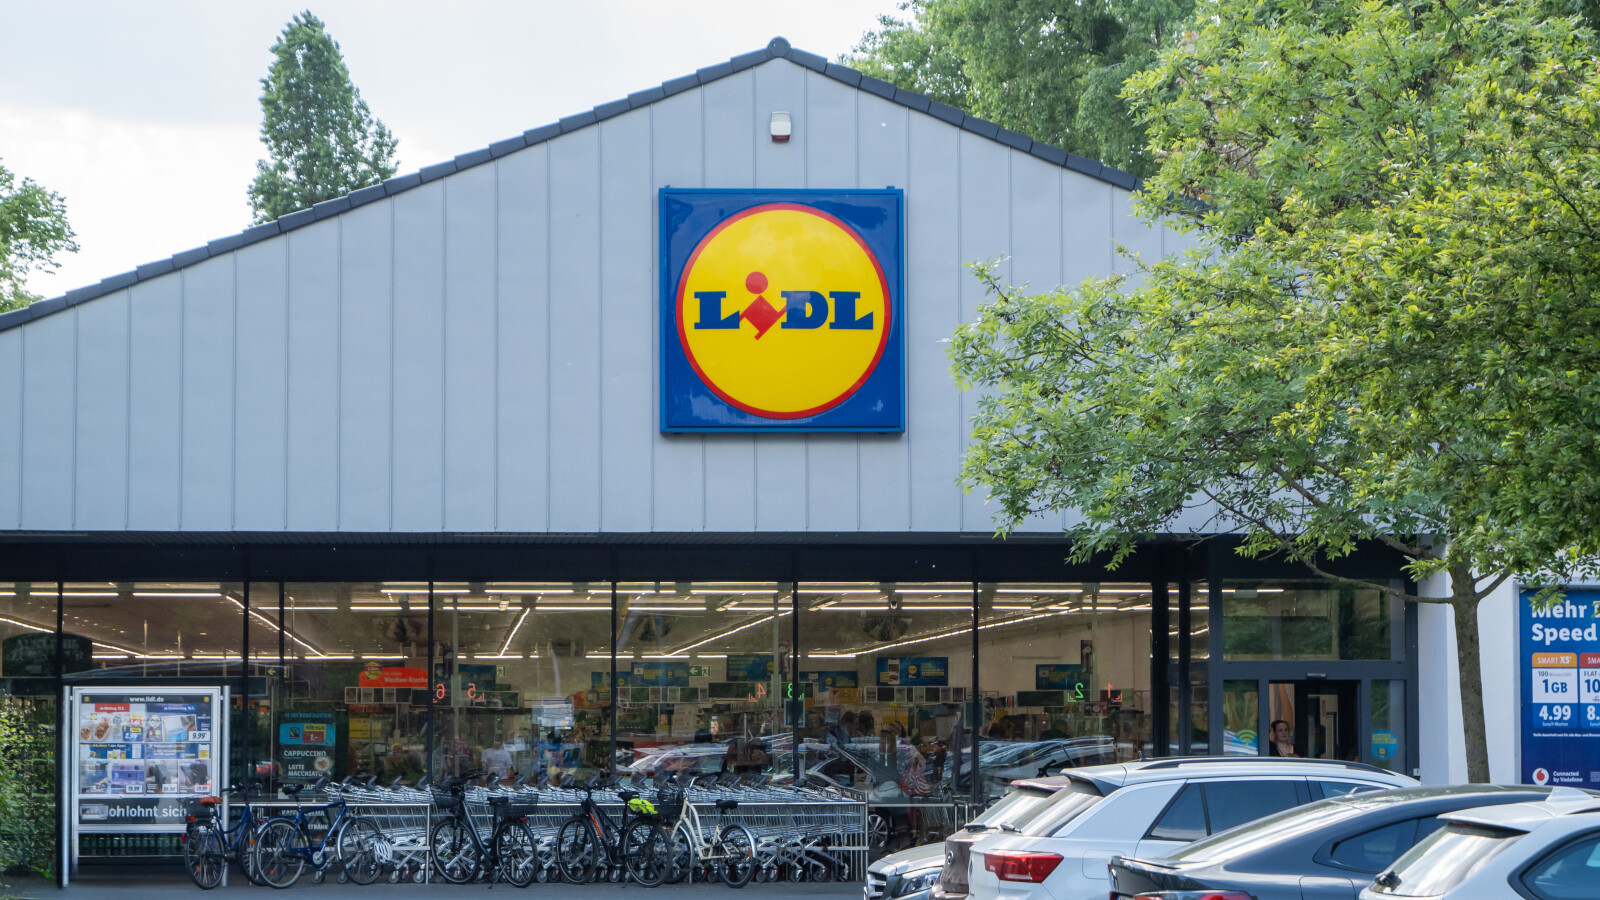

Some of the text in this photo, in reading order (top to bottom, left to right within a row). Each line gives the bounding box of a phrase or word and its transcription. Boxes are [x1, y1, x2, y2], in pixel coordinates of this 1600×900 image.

[1532, 600, 1587, 618] Mehr
[1532, 623, 1598, 646] Speed
[1537, 656, 1573, 665] SMART XS
[1587, 657, 1600, 665] SMA
[1539, 704, 1572, 721] 4.99
[1587, 705, 1600, 721] 8.
[108, 805, 158, 817] ohlohnt
